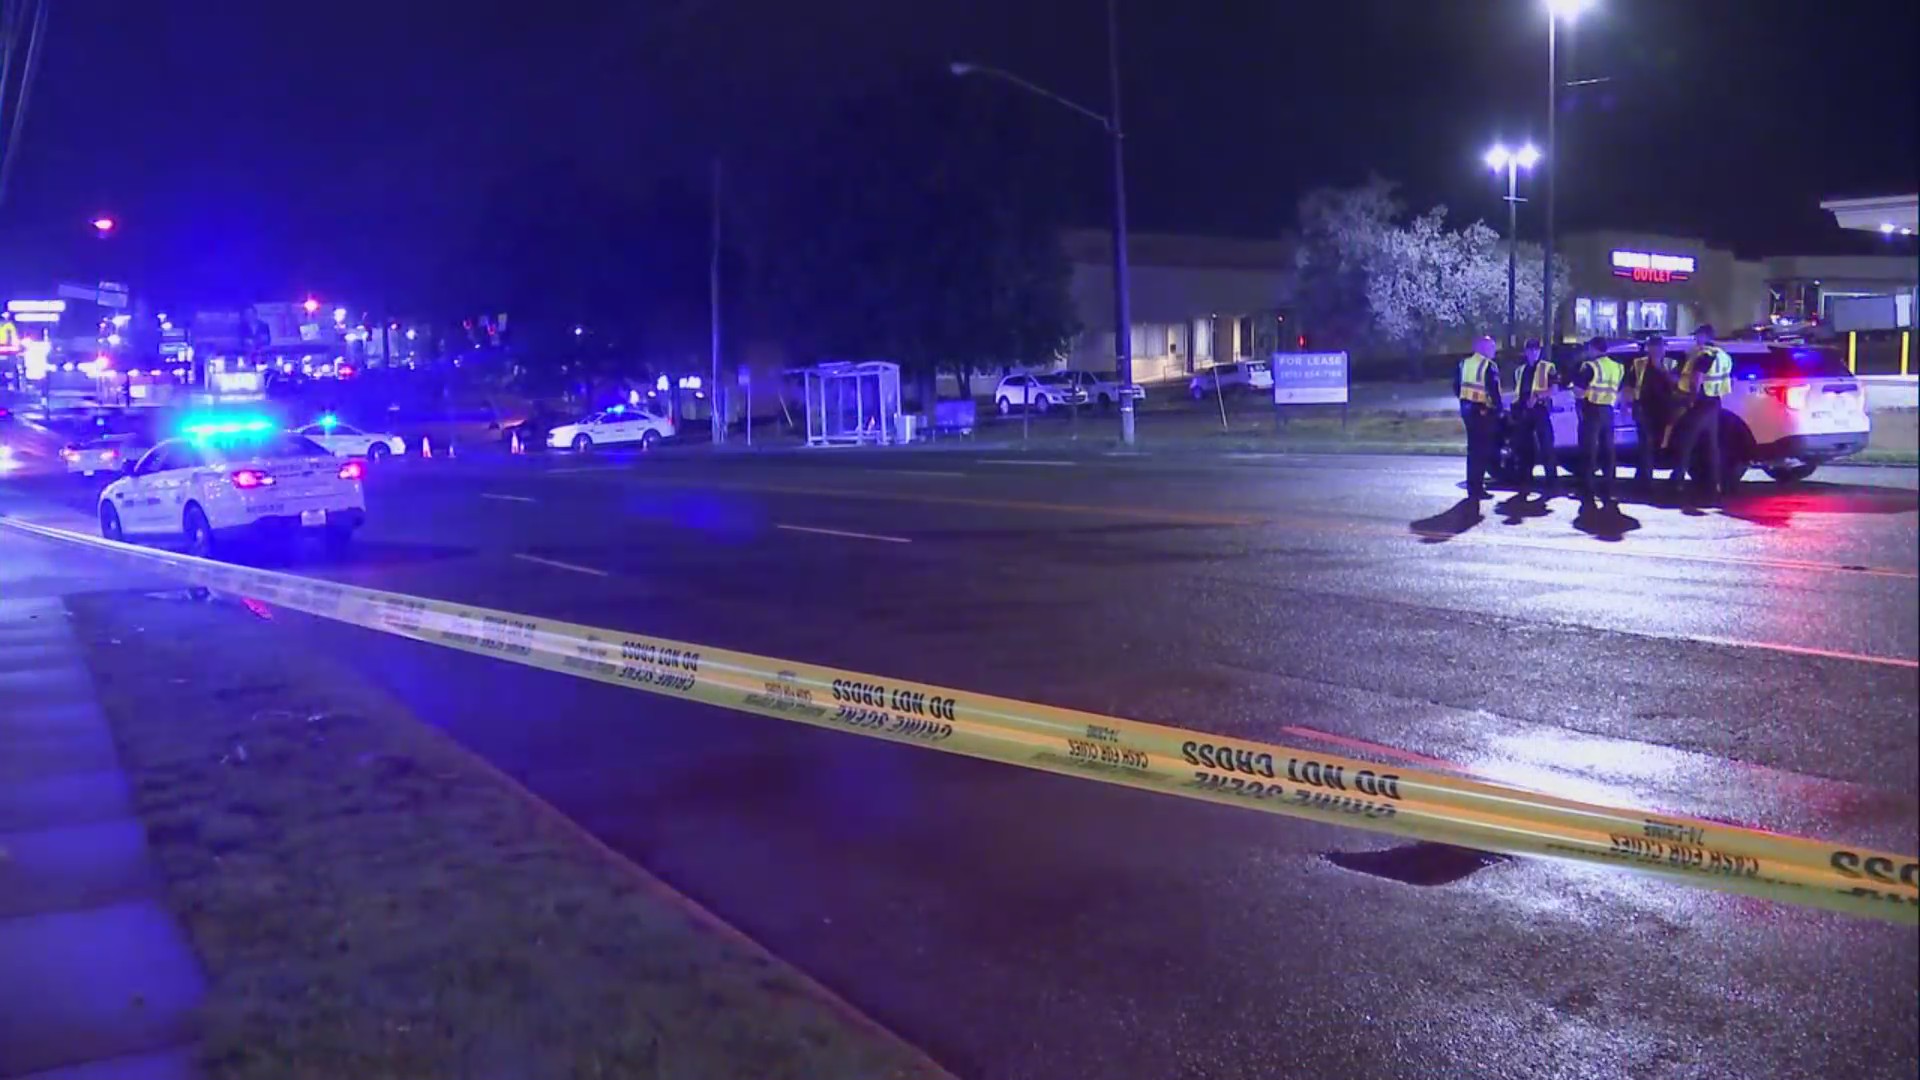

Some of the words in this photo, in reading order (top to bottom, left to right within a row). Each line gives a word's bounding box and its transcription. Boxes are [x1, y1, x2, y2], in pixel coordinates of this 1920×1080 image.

[1633, 268, 1671, 282] OUTLET
[1279, 356, 1302, 366] FOR
[1307, 356, 1342, 366] LEASE
[622, 641, 655, 663] CROSS
[658, 646, 679, 669] NOT
[682, 651, 700, 672] DO
[655, 674, 696, 691] CRIME
[832, 679, 884, 708] CROSS
[891, 688, 924, 716] NOT
[929, 696, 956, 721] DO
[829, 704, 889, 729] SCENE
[886, 715, 953, 740] CRIME
[1101, 745, 1121, 763] FOR
[1123, 749, 1149, 768] CASH
[1181, 741, 1275, 778] CROSS
[1184, 771, 1283, 799] SCENE
[1287, 758, 1347, 790] NOT
[1356, 769, 1402, 800] DO
[1608, 833, 1663, 859] CLUES
[1669, 844, 1702, 866] FOR
[1710, 850, 1760, 876] CASH
